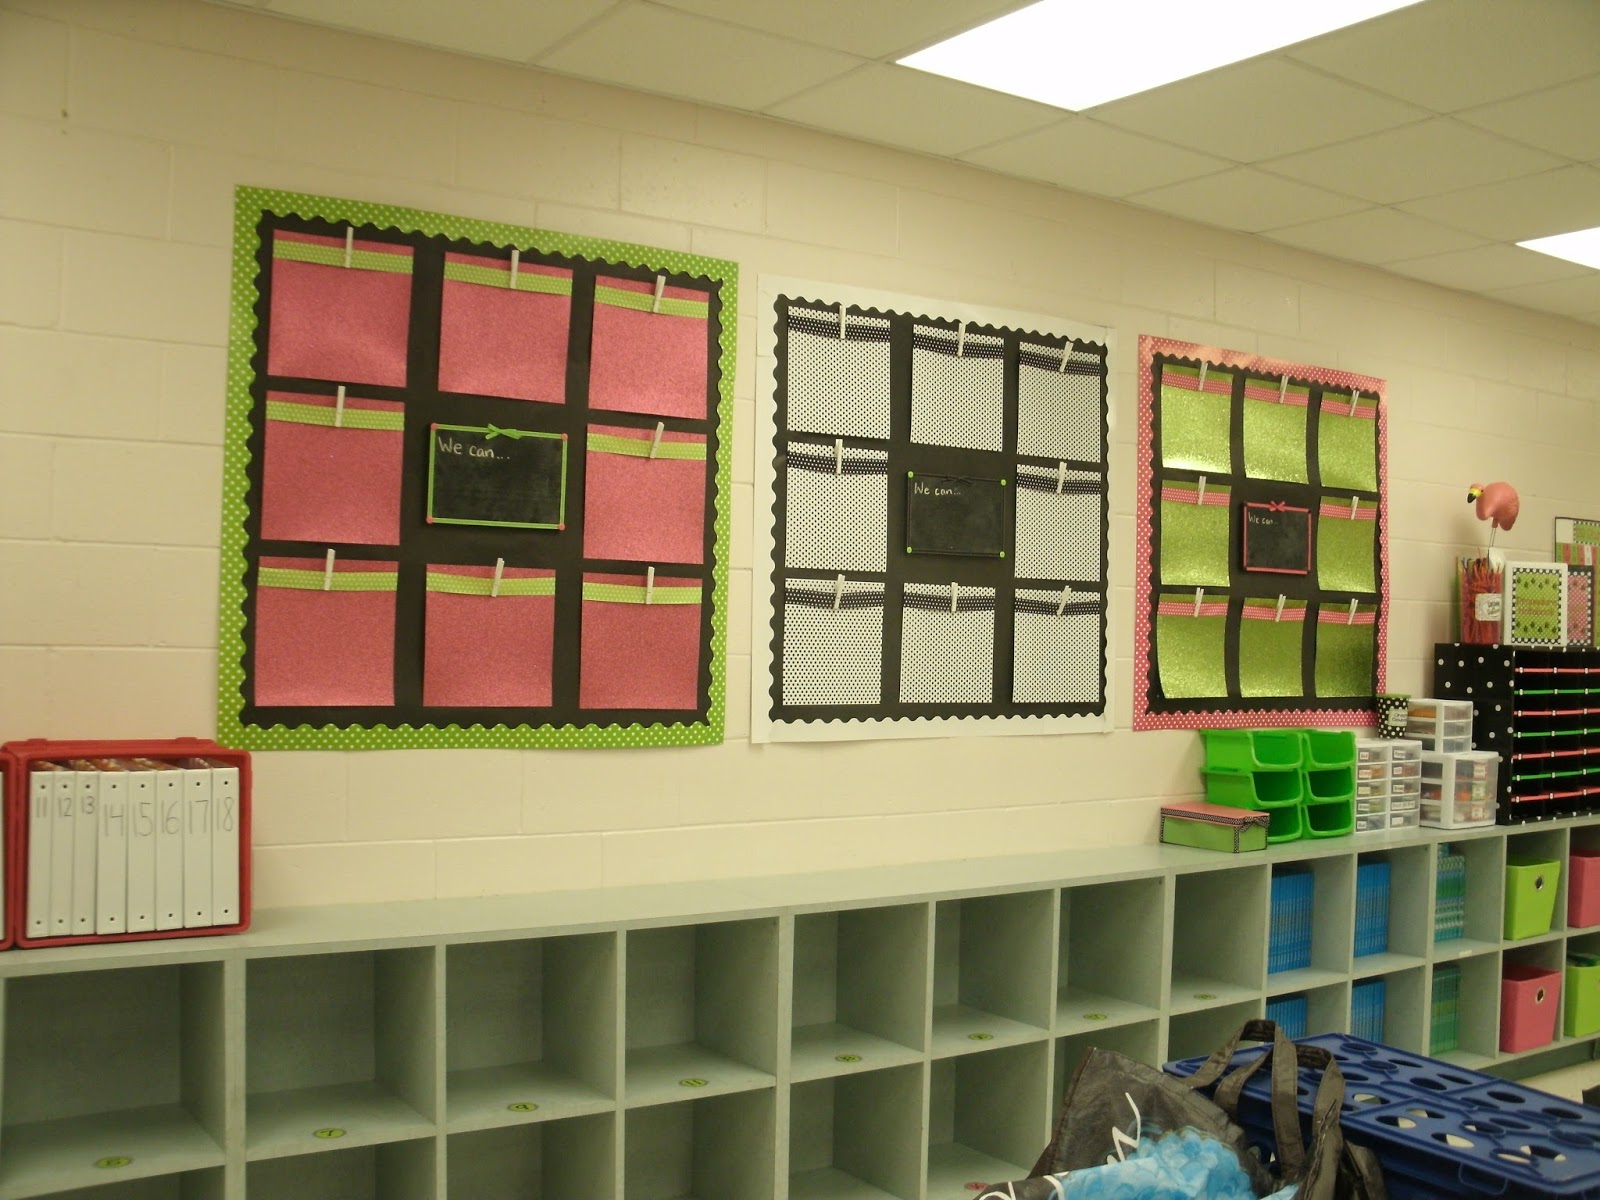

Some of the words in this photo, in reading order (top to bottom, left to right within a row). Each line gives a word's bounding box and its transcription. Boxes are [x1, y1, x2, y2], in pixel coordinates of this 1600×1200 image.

[438, 436, 463, 455] We
[914, 481, 931, 495] We
[1248, 511, 1260, 524] We
[35, 796, 48, 818] 11
[57, 797, 73, 818] 12
[80, 795, 96, 815] 13
[216, 796, 235, 832] 18
[103, 802, 125, 837] 14
[133, 801, 153, 837] 15
[161, 800, 181, 834] 16
[188, 799, 209, 834] 17
